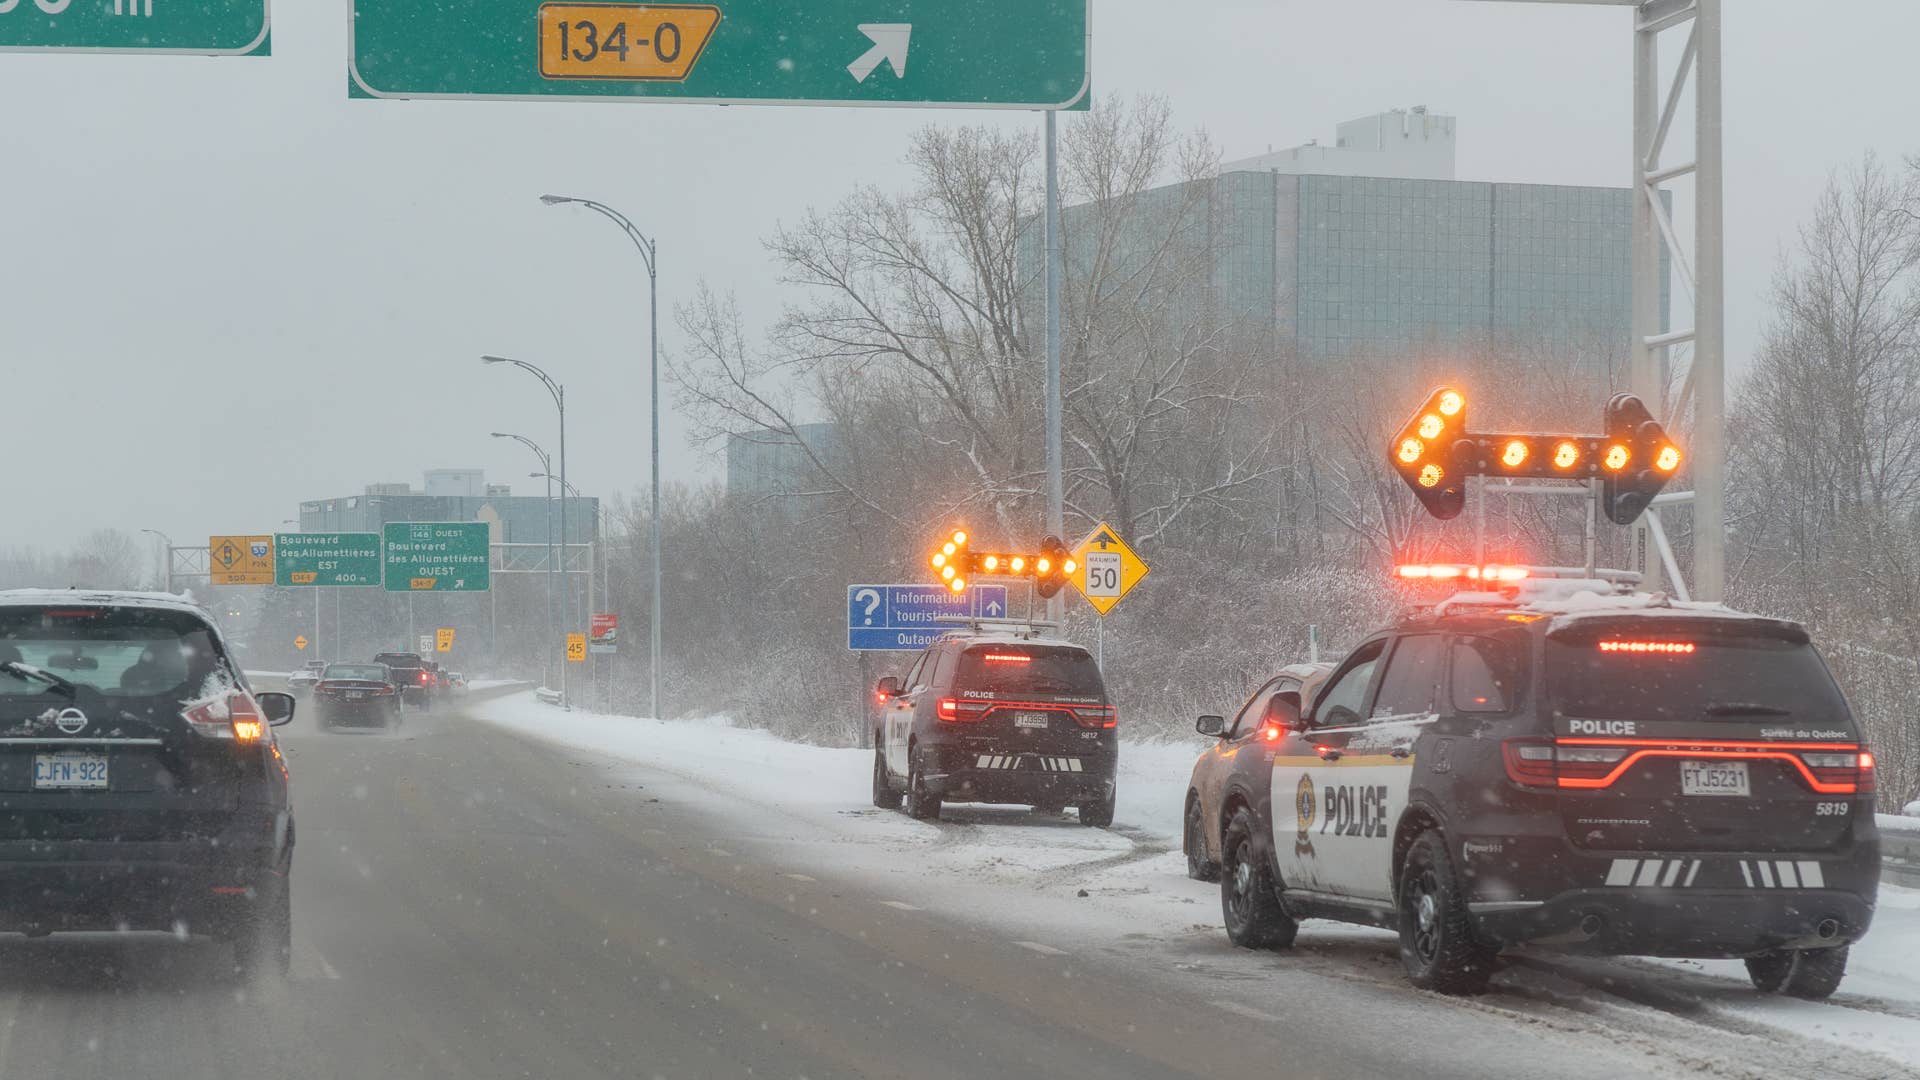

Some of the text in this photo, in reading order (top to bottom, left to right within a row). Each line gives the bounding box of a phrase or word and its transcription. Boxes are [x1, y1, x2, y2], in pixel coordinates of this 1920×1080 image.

[280, 536, 339, 545] Boulevard
[388, 542, 446, 551] Boulevard
[281, 549, 376, 558] des Allumettières
[388, 554, 485, 564] des Allumettières
[318, 561, 338, 570] EST
[419, 567, 455, 576] OUEST
[335, 573, 357, 582] 400
[1090, 567, 1117, 589] 50
[896, 591, 967, 604] Information
[568, 643, 583, 654] 45
[963, 690, 995, 700] POLICE
[1570, 719, 1636, 735] POLICE
[1081, 731, 1098, 739] 5812
[1760, 727, 1848, 740] Sûreté du Québec
[1683, 769, 1745, 787] FTJ5231
[1320, 785, 1388, 839] POLICE
[1815, 802, 1849, 816] 5819
